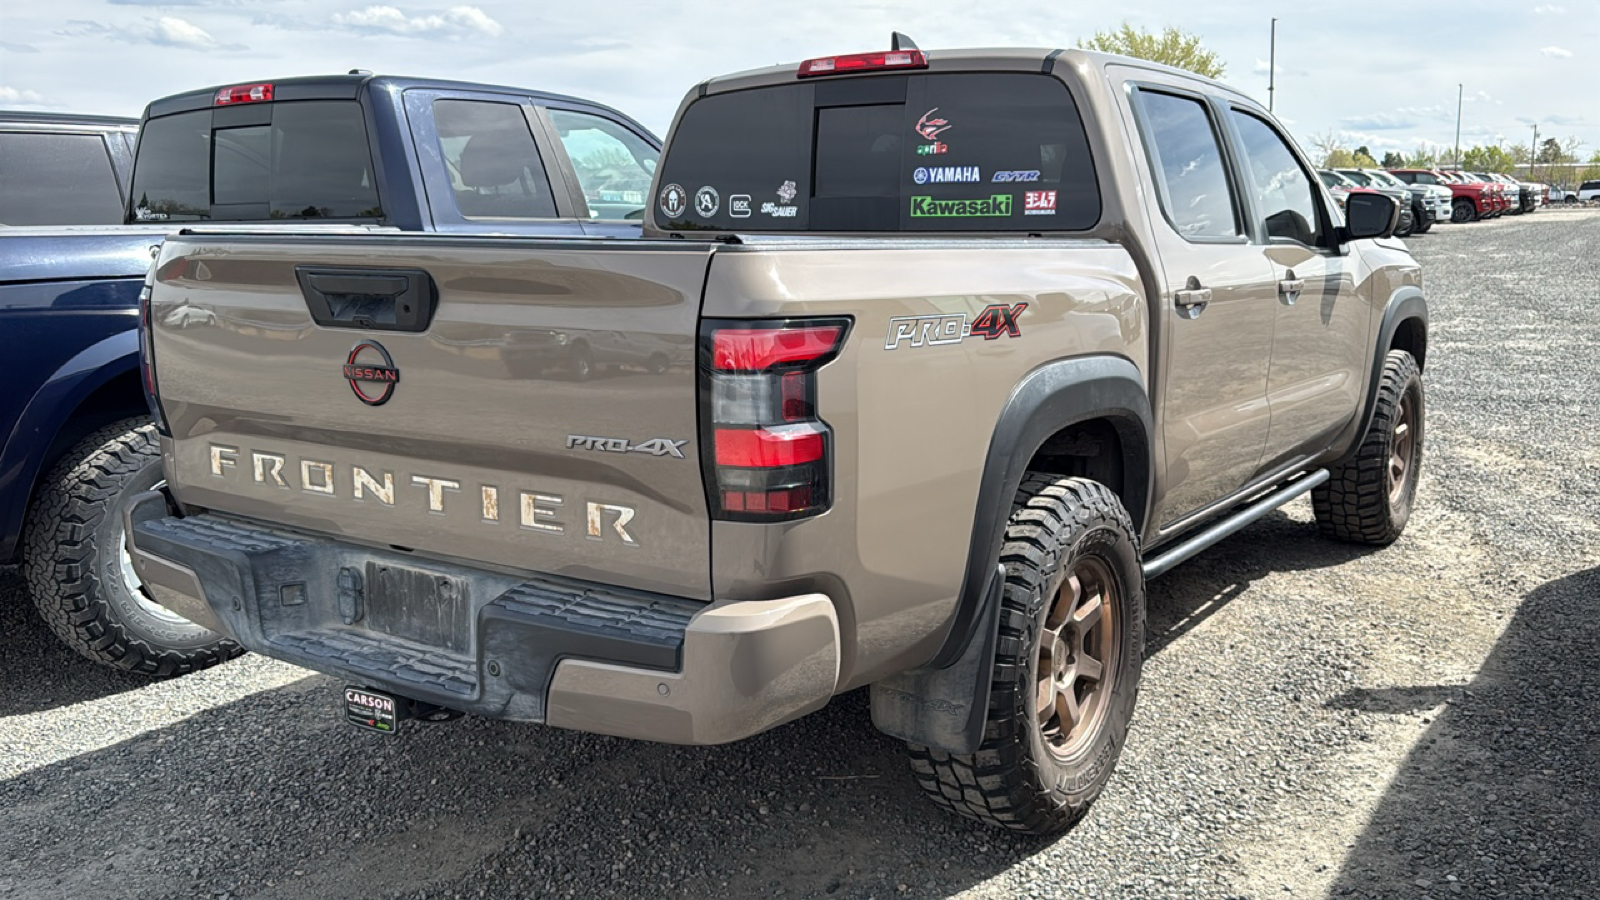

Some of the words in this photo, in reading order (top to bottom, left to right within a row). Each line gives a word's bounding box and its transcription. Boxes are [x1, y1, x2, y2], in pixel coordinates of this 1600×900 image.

[929, 166, 980, 183] YAMAHA
[911, 195, 1012, 216] Kawasaki
[344, 366, 397, 381] NISSAN
[565, 434, 690, 459] PRO-4X
[208, 443, 639, 548] FRONTIER
[346, 691, 392, 711] CARSON
